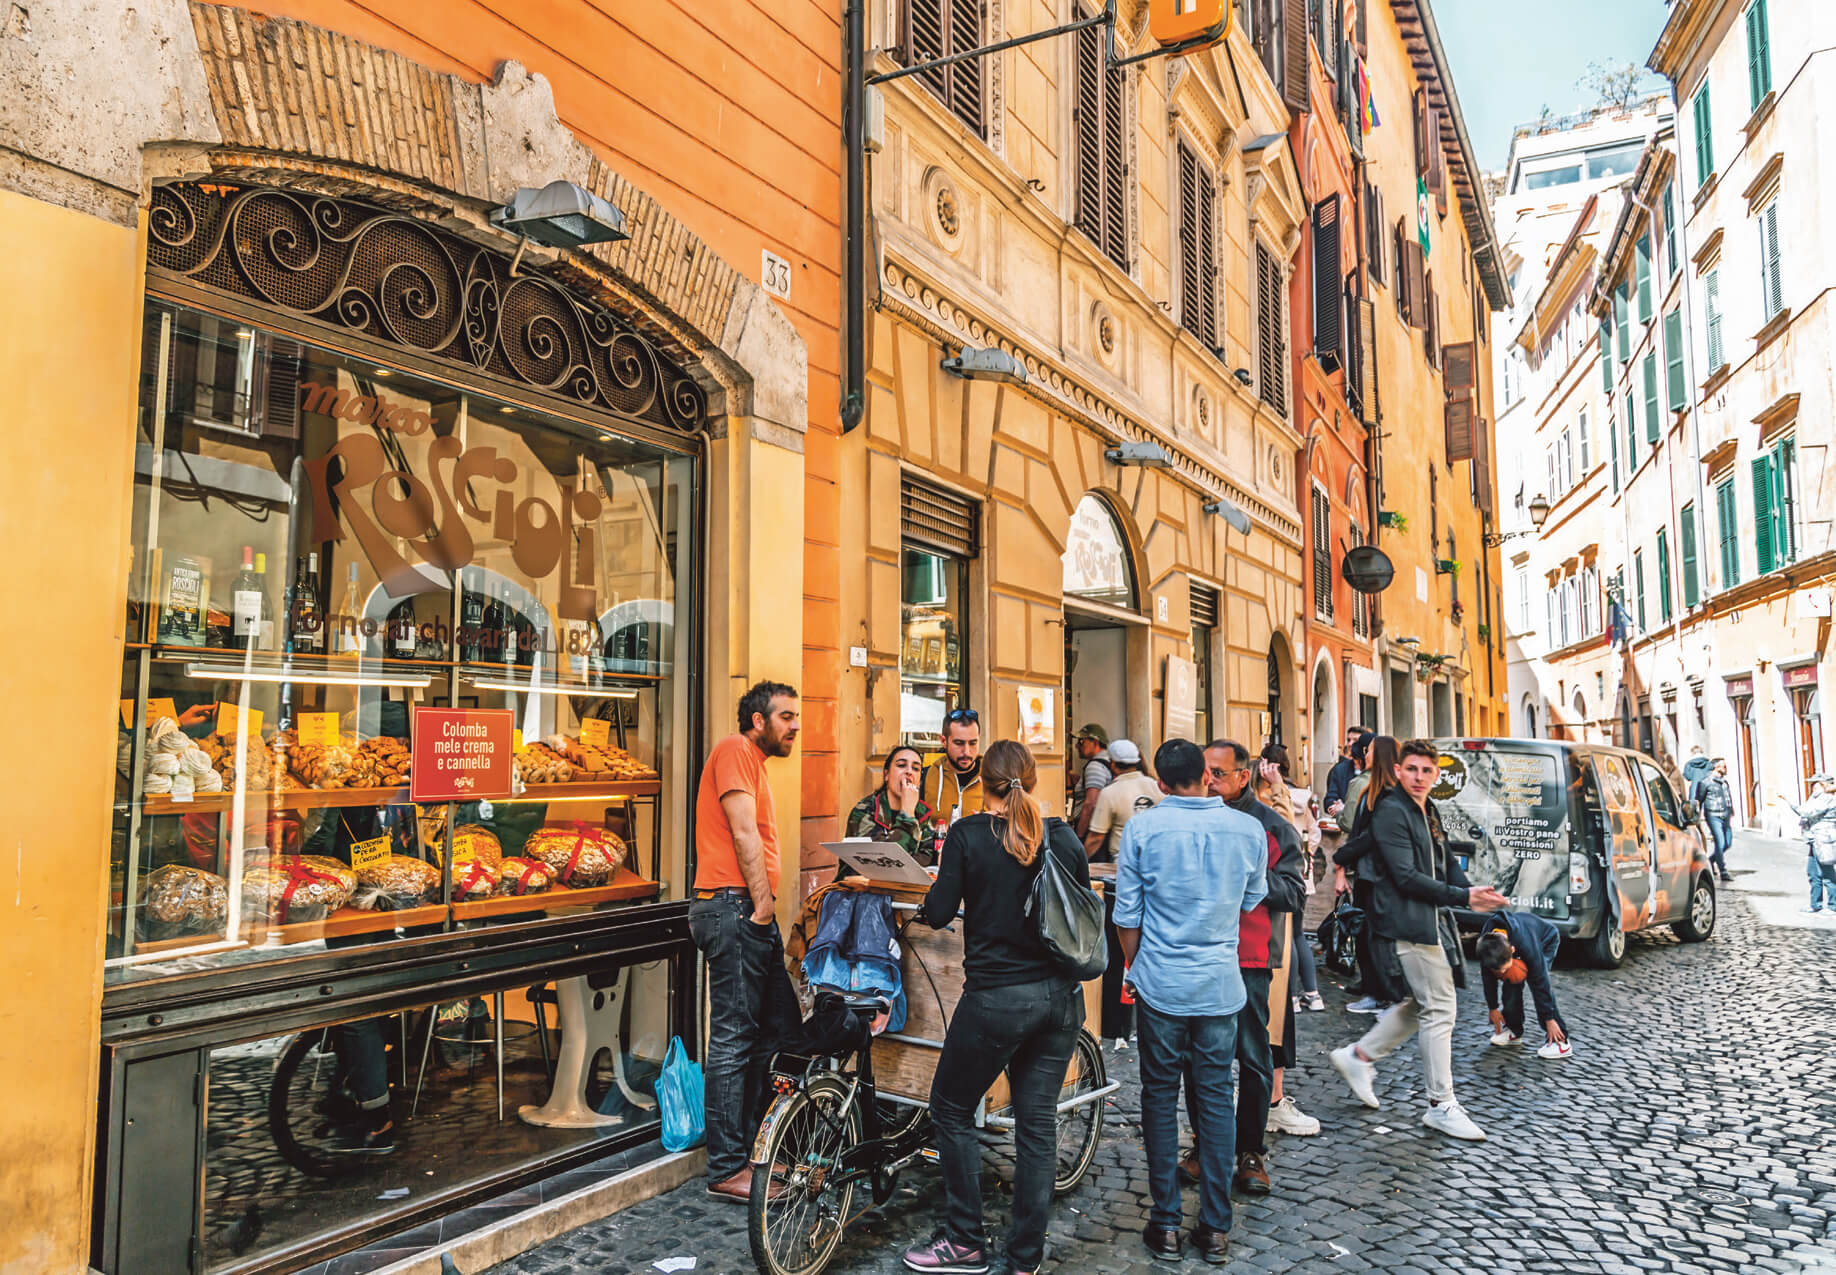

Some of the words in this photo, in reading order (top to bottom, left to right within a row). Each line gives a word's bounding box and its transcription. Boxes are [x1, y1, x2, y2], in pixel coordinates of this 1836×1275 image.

[766, 257, 788, 293] 33
[300, 381, 440, 437] marco
[291, 600, 378, 638] forno
[518, 624, 548, 652] dal
[559, 627, 604, 656] 1824
[442, 721, 488, 738] Colomba
[434, 741, 460, 754] mele
[462, 742, 495, 754] crema
[437, 758, 444, 770] e
[446, 755, 491, 770] cannella
[1506, 817, 1549, 827] portiamo
[1504, 827, 1534, 838] Vostro
[1536, 830, 1560, 839] pane
[1501, 839, 1507, 847] a
[1509, 840, 1554, 850] emissioni
[1514, 850, 1540, 859] ZERO
